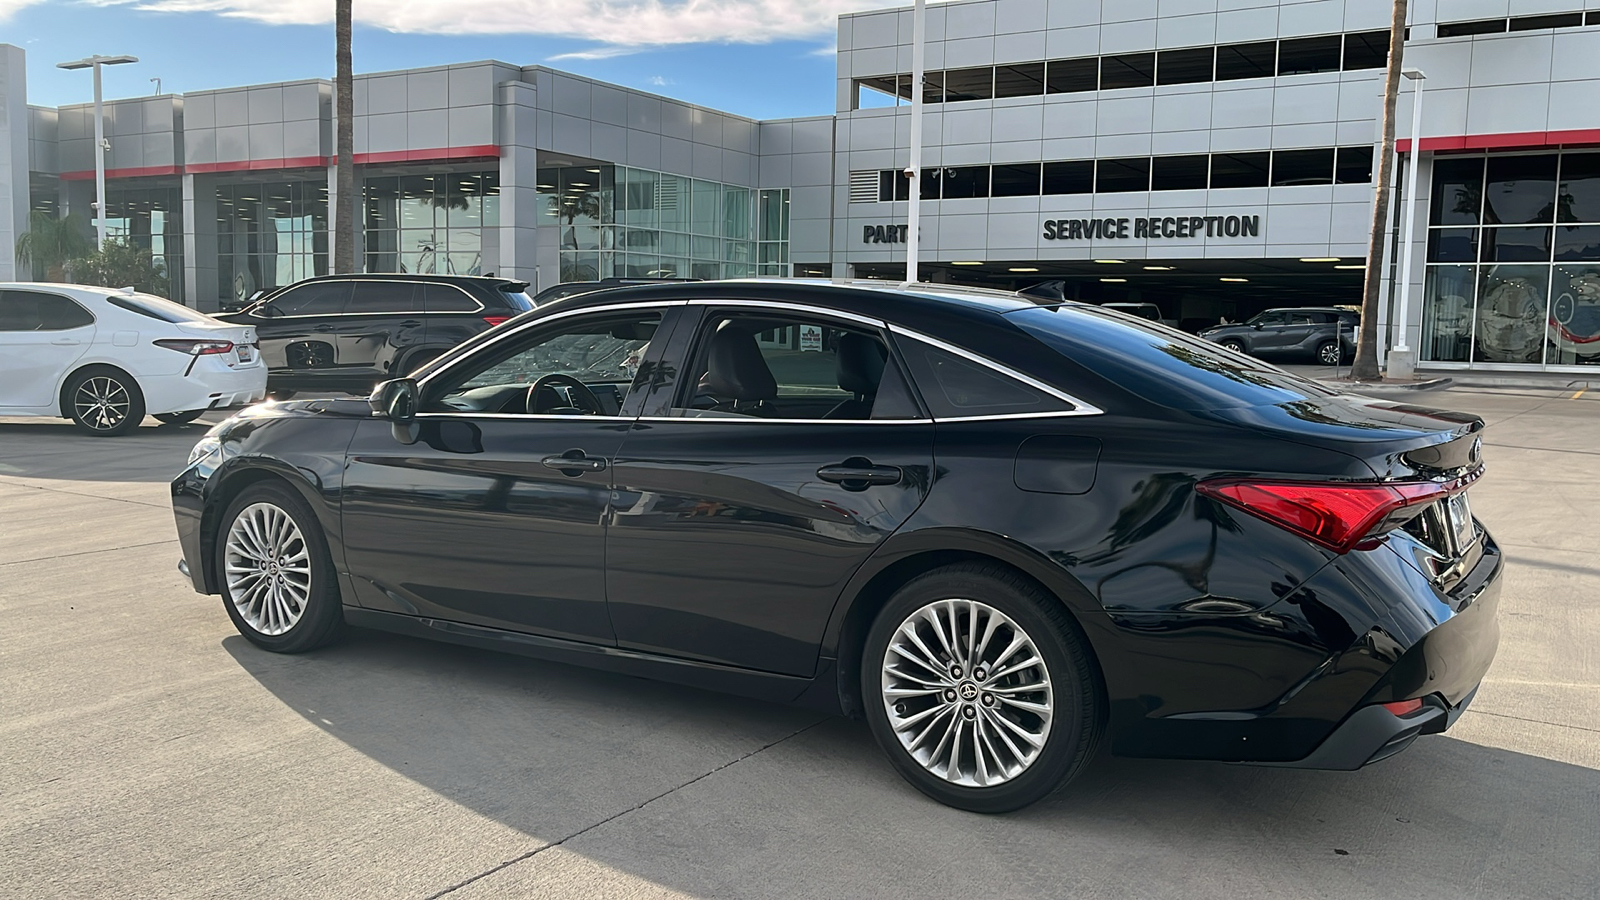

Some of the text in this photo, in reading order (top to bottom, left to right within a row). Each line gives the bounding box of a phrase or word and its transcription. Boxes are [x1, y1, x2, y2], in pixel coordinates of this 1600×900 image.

[863, 224, 920, 244] PART
[1043, 215, 1259, 240] SERVICE RECEPTION
